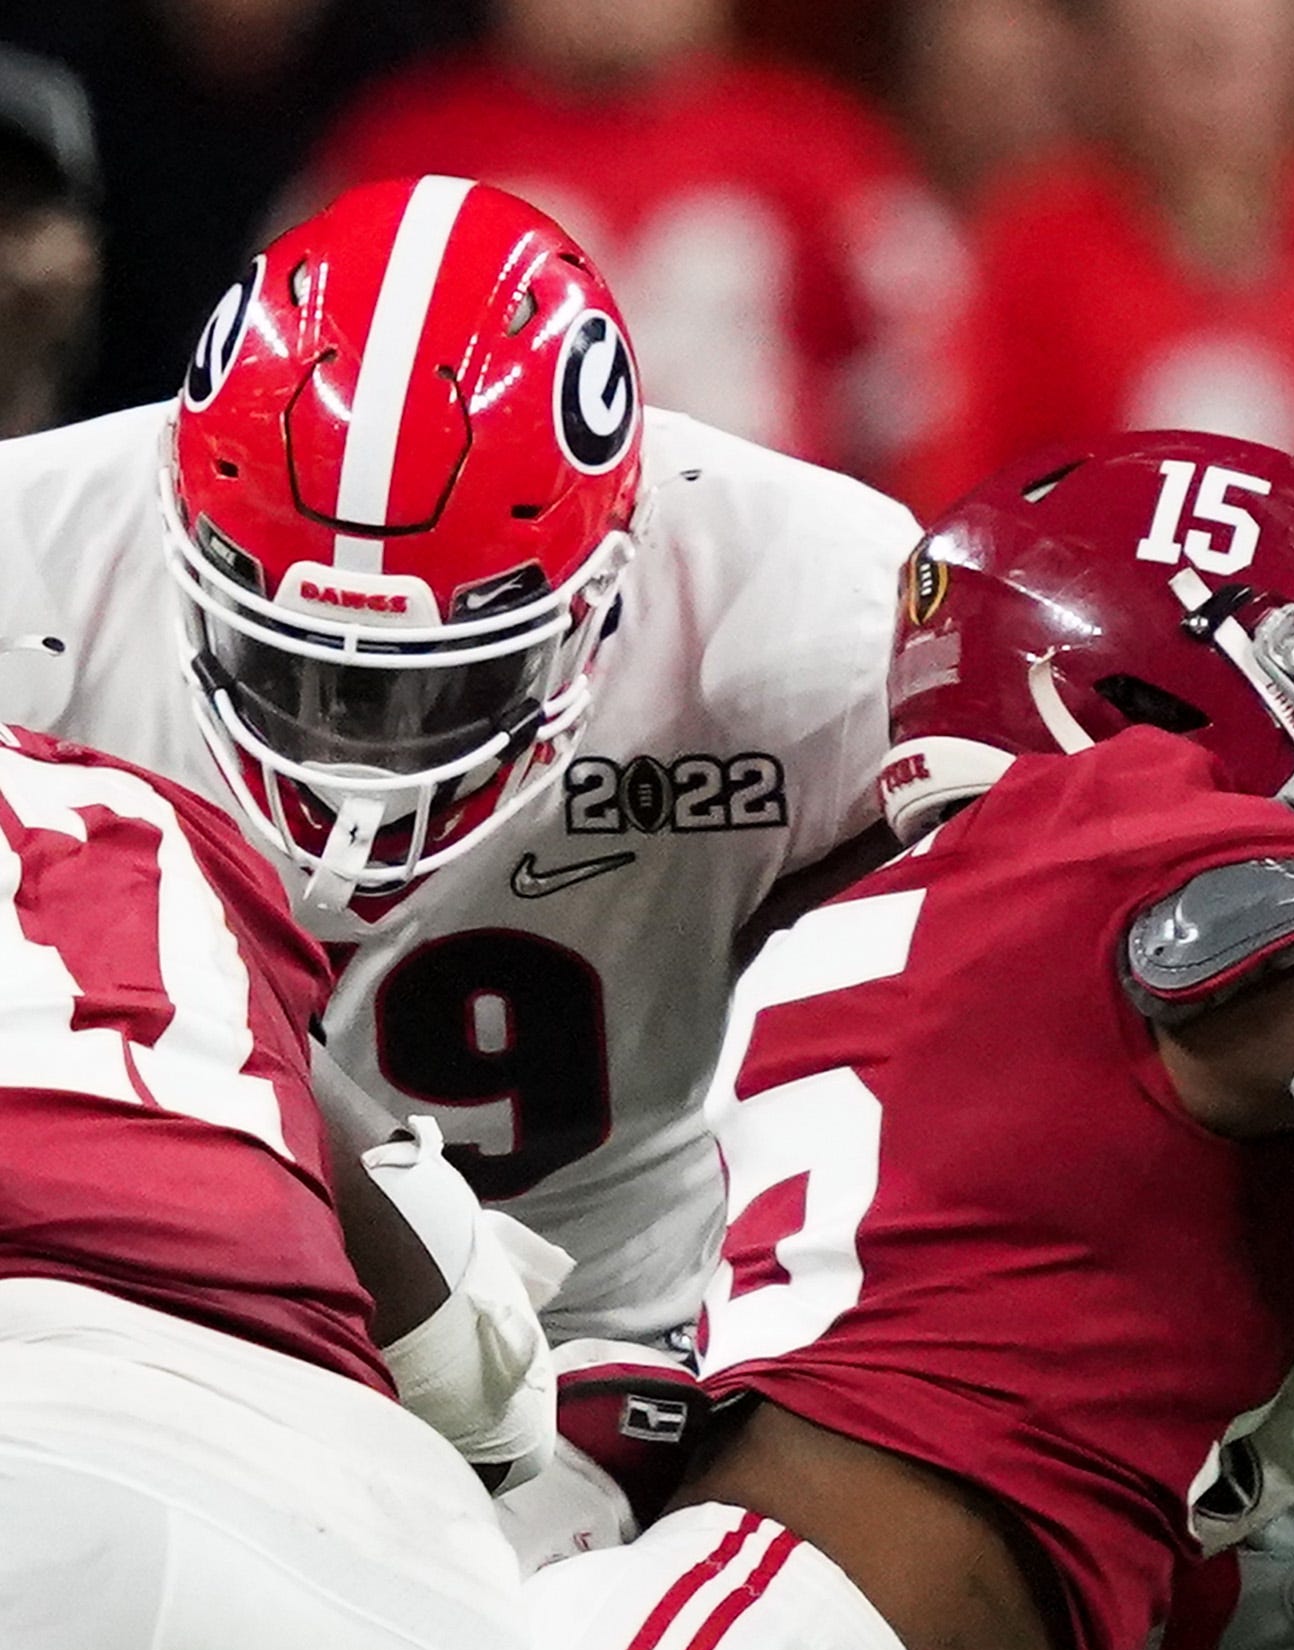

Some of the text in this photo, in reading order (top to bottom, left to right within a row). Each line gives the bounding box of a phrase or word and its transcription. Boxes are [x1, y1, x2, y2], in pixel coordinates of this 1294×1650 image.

[553, 308, 636, 474] G
[1136, 459, 1272, 577] 15
[300, 580, 408, 614] DAWGS
